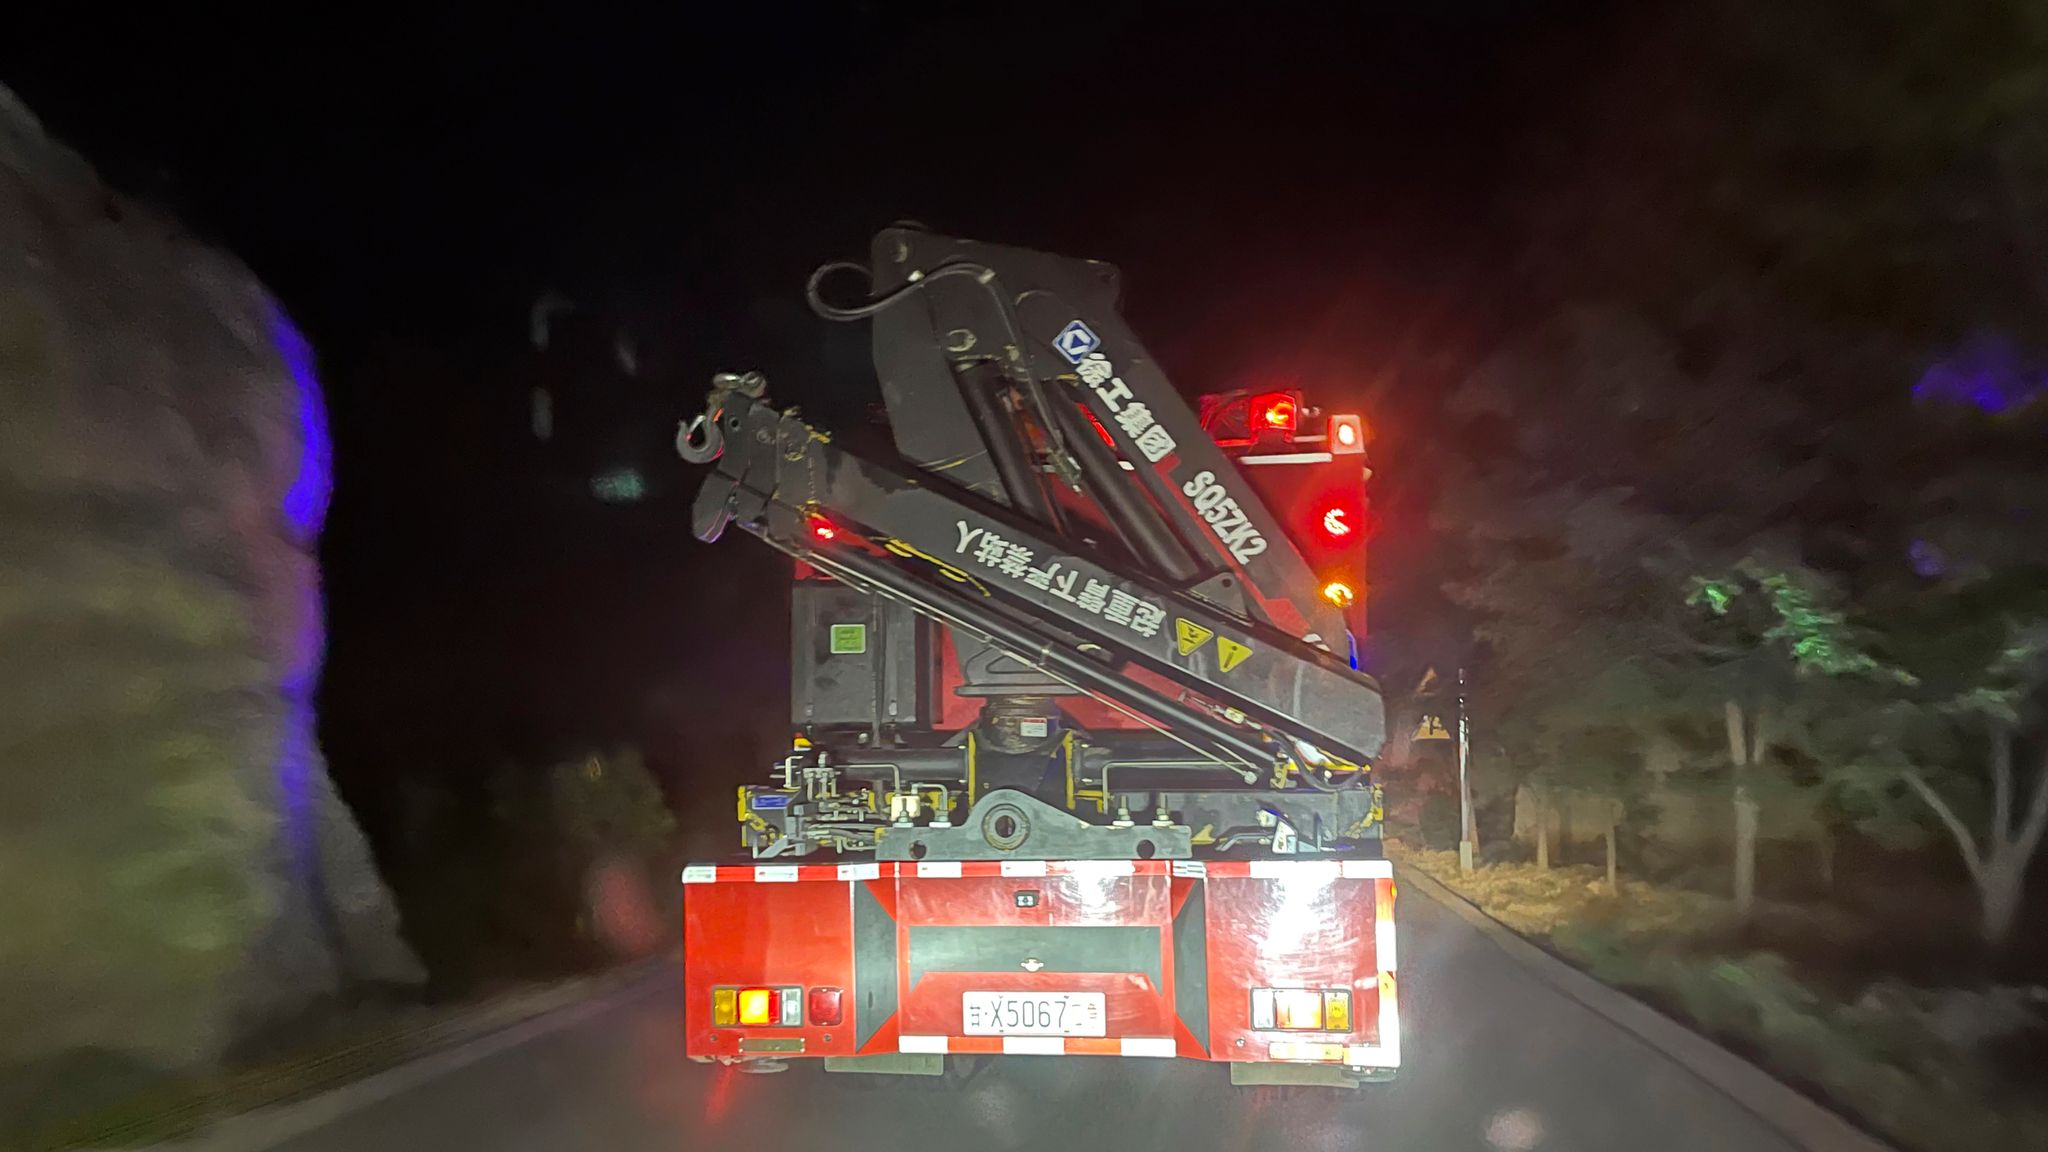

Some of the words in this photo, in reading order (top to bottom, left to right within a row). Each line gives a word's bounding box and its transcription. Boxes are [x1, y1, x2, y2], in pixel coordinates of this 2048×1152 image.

[1076, 352, 1176, 462] 徐工集团
[1183, 471, 1267, 565] SQ5ZK2
[956, 520, 1167, 637] 起重臂下严禁站人
